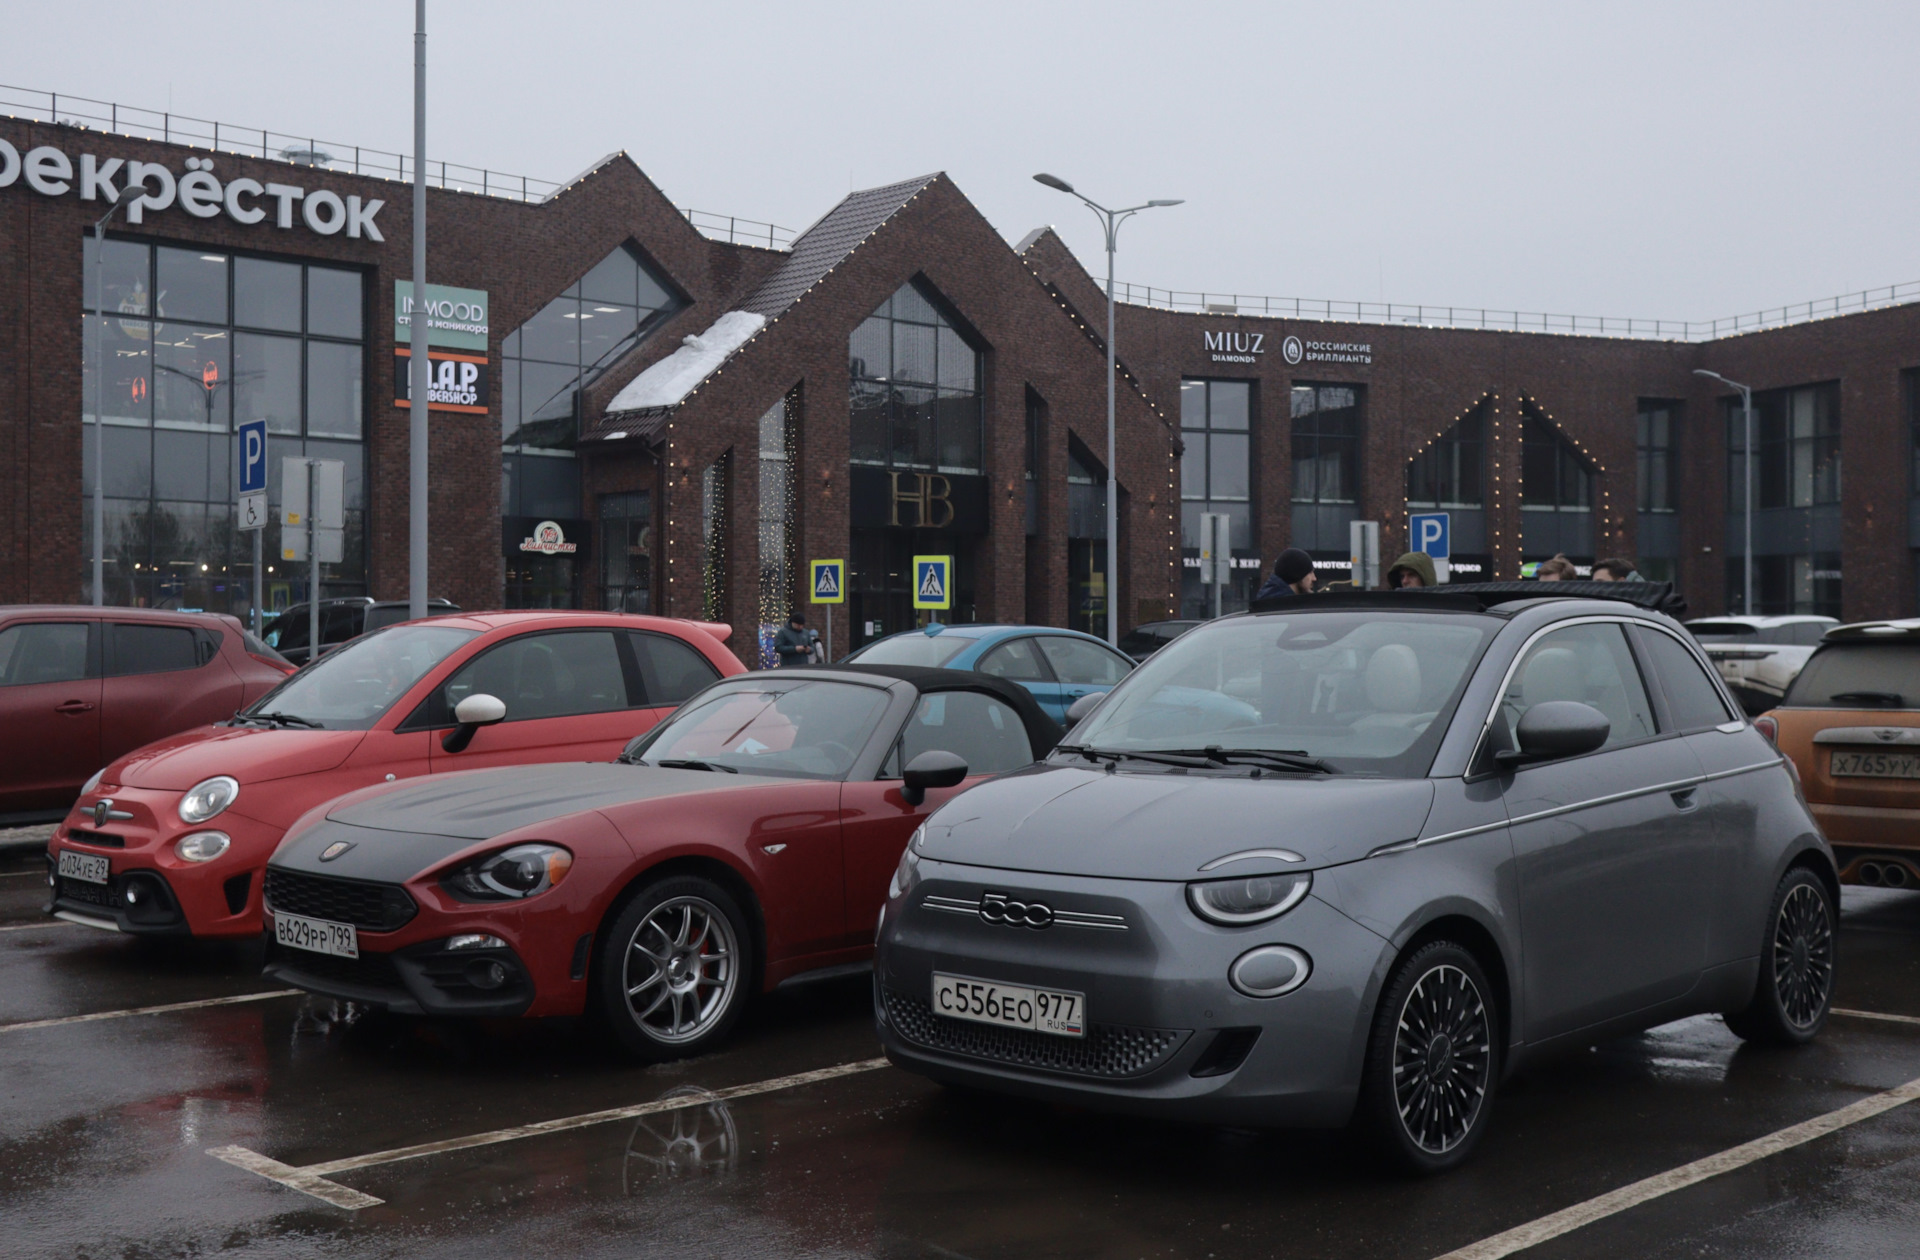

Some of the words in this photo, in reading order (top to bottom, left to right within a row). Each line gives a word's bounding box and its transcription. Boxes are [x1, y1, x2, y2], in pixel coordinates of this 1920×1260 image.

[435, 320, 488, 335] маникюра
[1204, 331, 1264, 353] MIUZ
[1306, 341, 1371, 353] РОССИЙСКИЕ
[1212, 354, 1256, 363] DIAMONDS
[1306, 353, 1371, 364] БРИЛЛИАНТЫ
[407, 359, 479, 393] .A.P.
[246, 429, 262, 485] P
[888, 471, 955, 528] HB
[520, 537, 577, 552] Химчистка
[1421, 519, 1443, 554] P
[1837, 754, 1913, 775] Х765УУ
[95, 859, 106, 875] 29
[980, 893, 1052, 926] 500
[278, 918, 328, 950] В629РР
[329, 925, 351, 947] 799
[940, 982, 1033, 1024] С556ЕО
[1037, 993, 1076, 1021] 977
[1047, 1019, 1066, 1031] RUS
